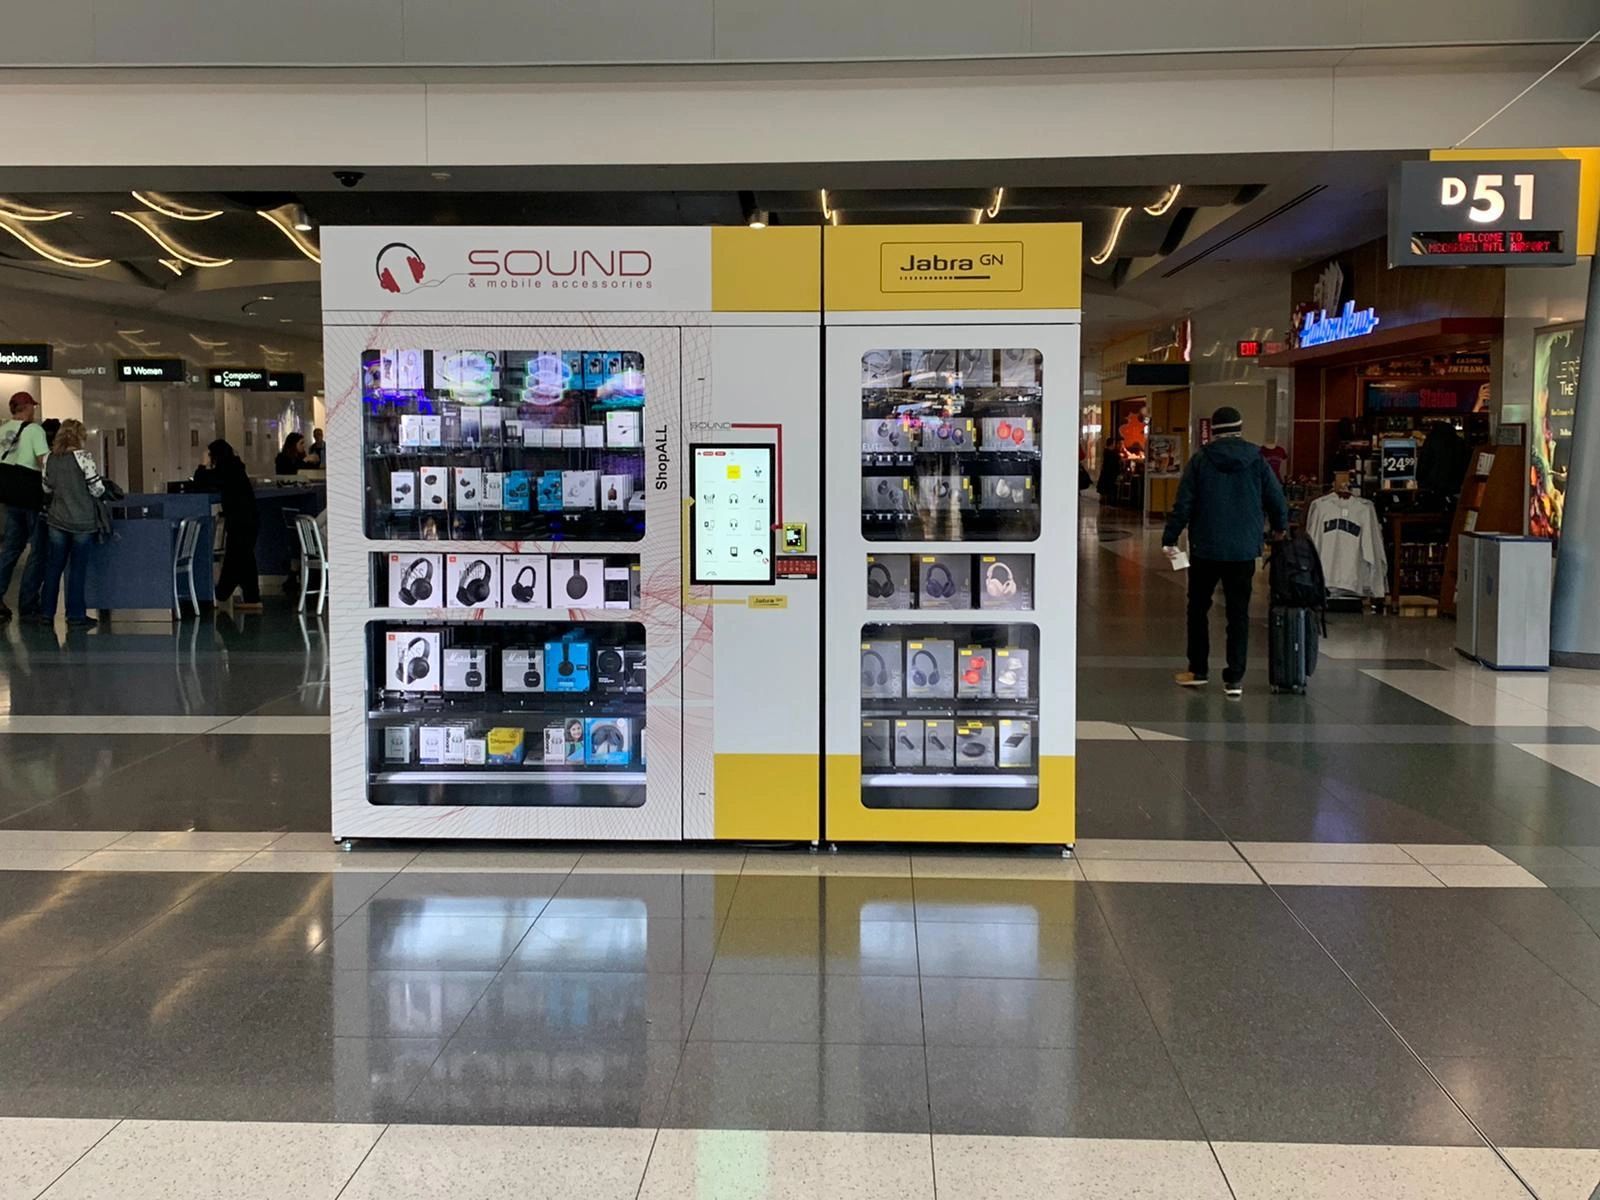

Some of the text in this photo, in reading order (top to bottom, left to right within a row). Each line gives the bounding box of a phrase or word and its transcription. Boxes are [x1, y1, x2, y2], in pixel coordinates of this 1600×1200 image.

[1458, 232, 1523, 242] WELCOME TO
[468, 250, 652, 276] SOUND
[900, 253, 1004, 272] Jabra GN
[468, 277, 653, 289] & mobile accessories
[1240, 341, 1258, 356] EXIT
[133, 366, 163, 376] Women
[222, 371, 262, 380] Companion
[1559, 381, 1574, 396] THE
[655, 424, 670, 490] ShopALL
